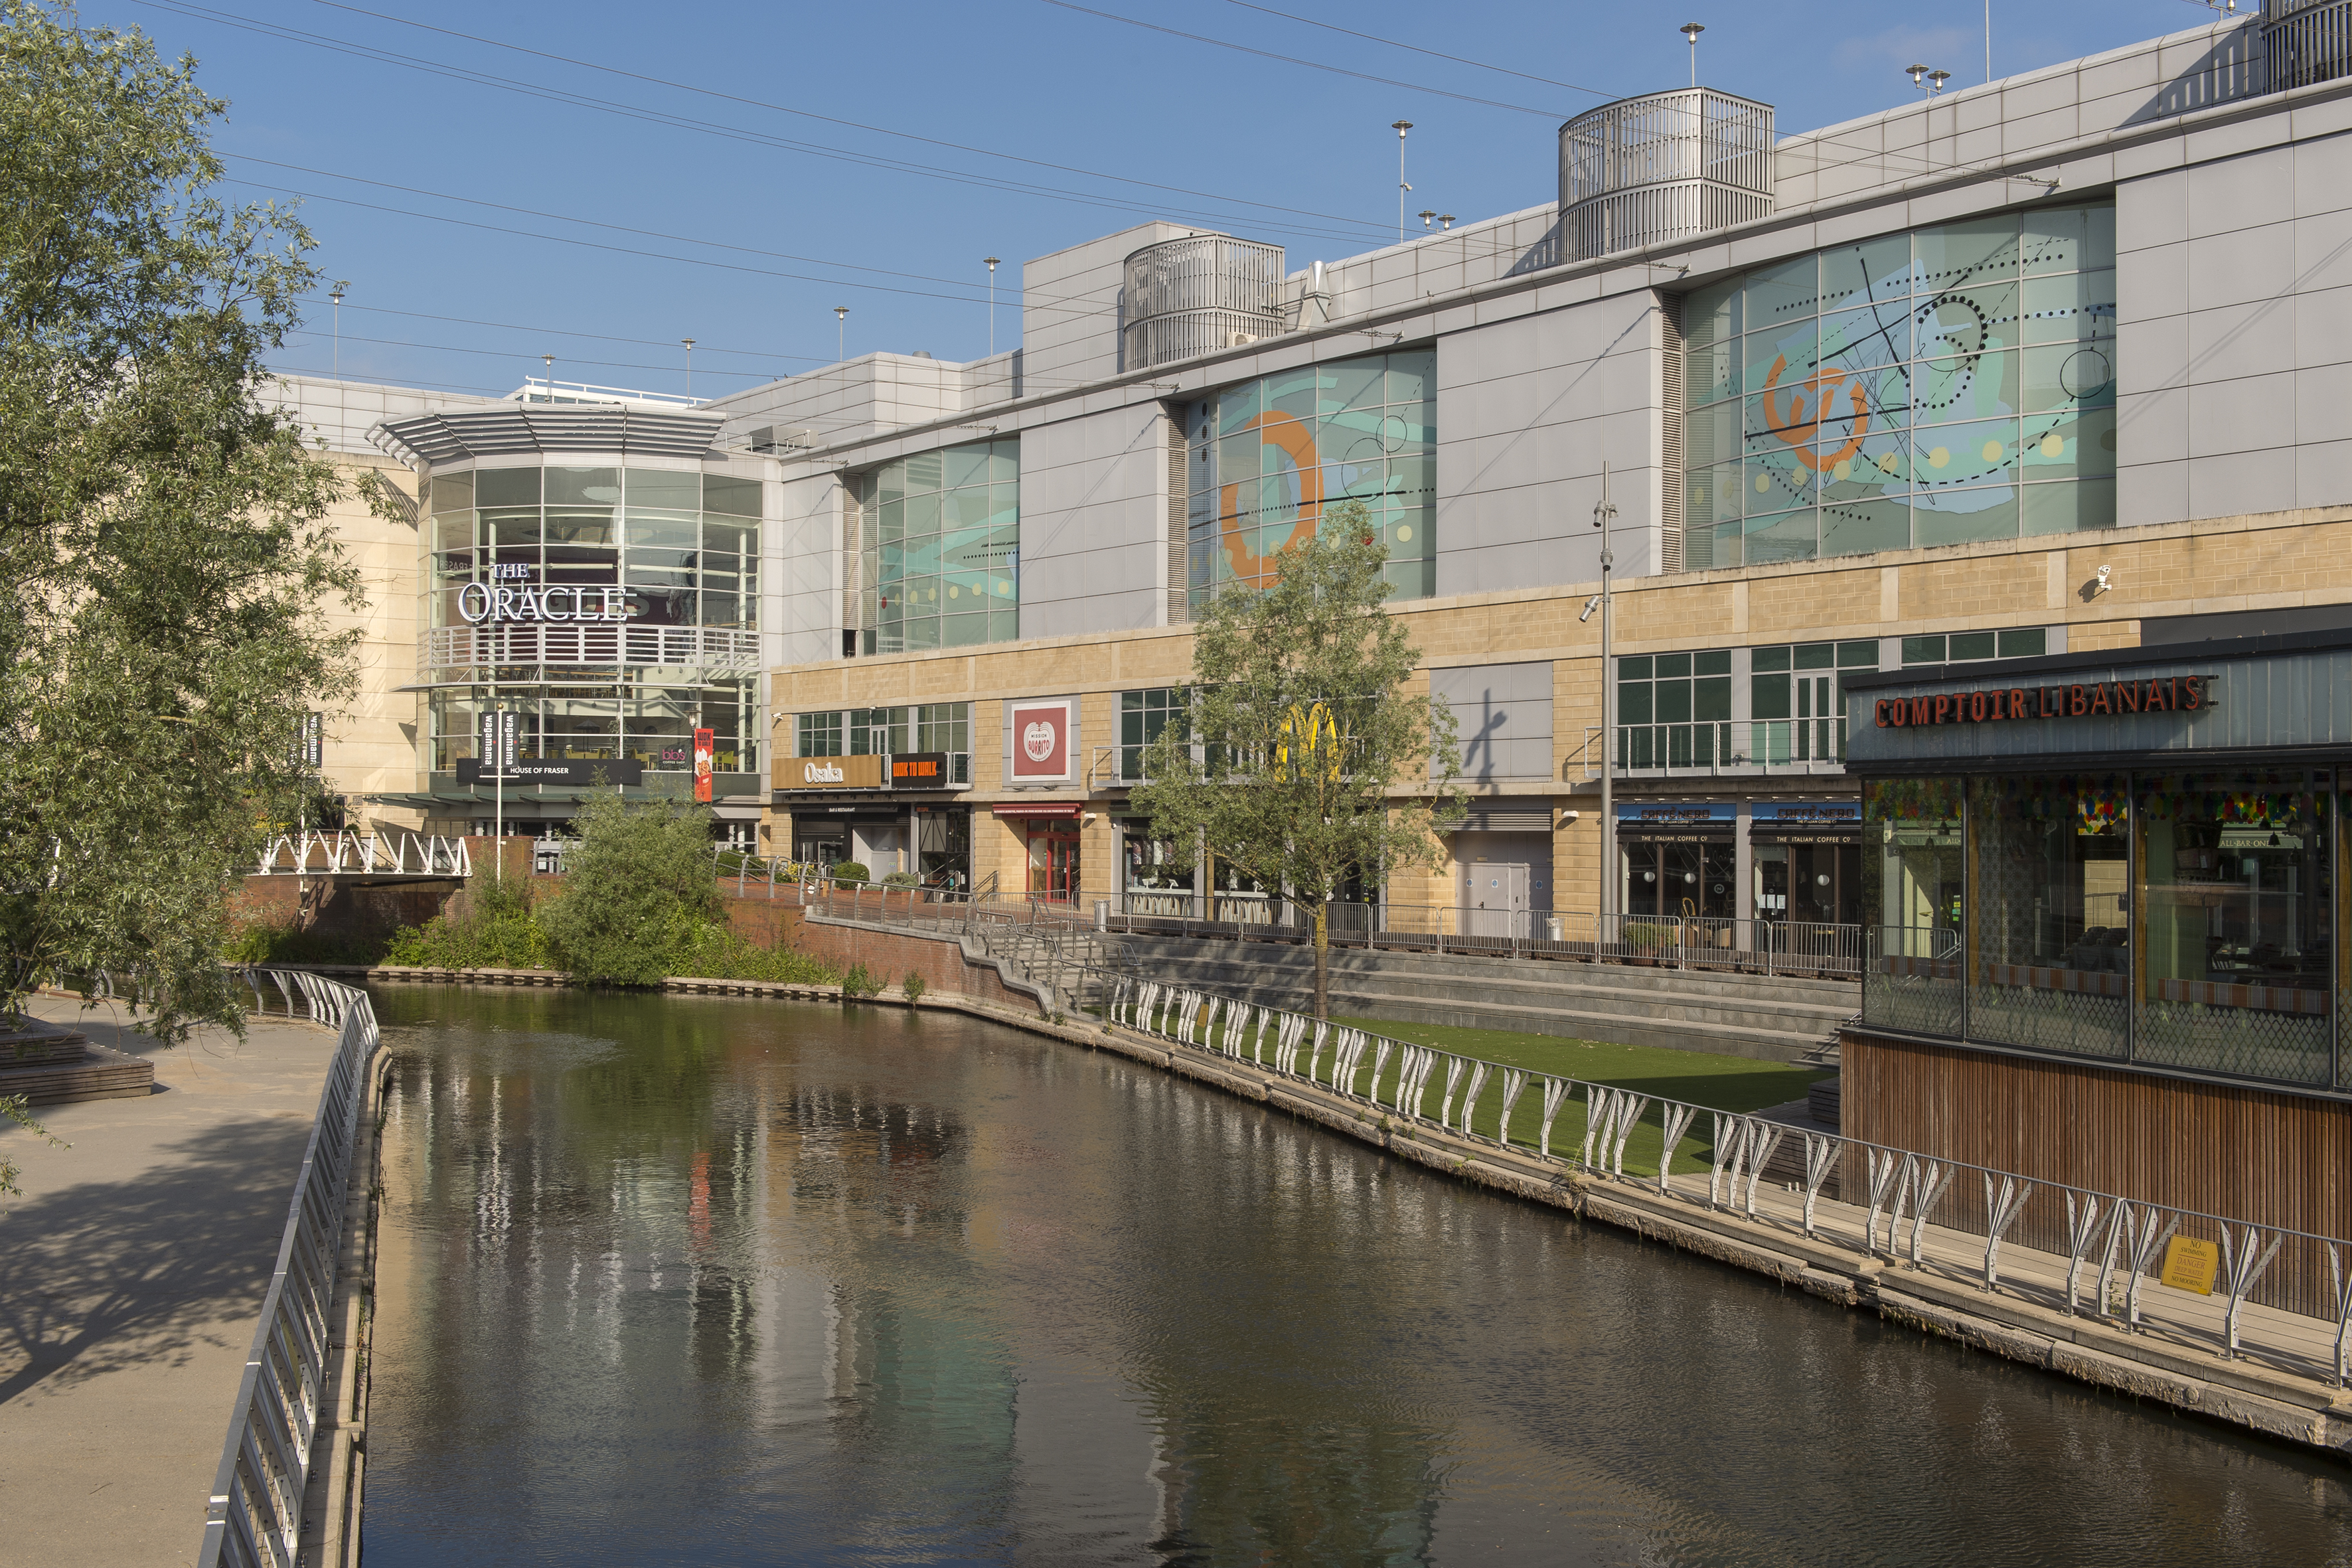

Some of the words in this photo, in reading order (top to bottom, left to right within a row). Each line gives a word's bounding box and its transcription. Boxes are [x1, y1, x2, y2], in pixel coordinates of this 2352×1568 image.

[489, 563, 530, 579] THE
[458, 582, 629, 622] ORACLE
[1875, 688, 2027, 728] COMPTOIR
[2040, 676, 2200, 717] LIBANAIS
[483, 715, 493, 765] wagamama
[505, 715, 514, 765] wagamama
[697, 732, 711, 741] WOK
[1028, 740, 1050, 755] BURRITO
[805, 761, 844, 783] Osaka
[893, 762, 908, 777] WOK
[909, 762, 917, 777] TO
[918, 761, 937, 776] WALK
[1678, 809, 1711, 819] NERO
[1819, 809, 1855, 819] NERO
[2181, 1247, 2207, 1257] SWIMMING
[2189, 1240, 2201, 1249] NO
[2177, 1257, 2205, 1269] DANGER
[2179, 1278, 2203, 1287] MOORING
